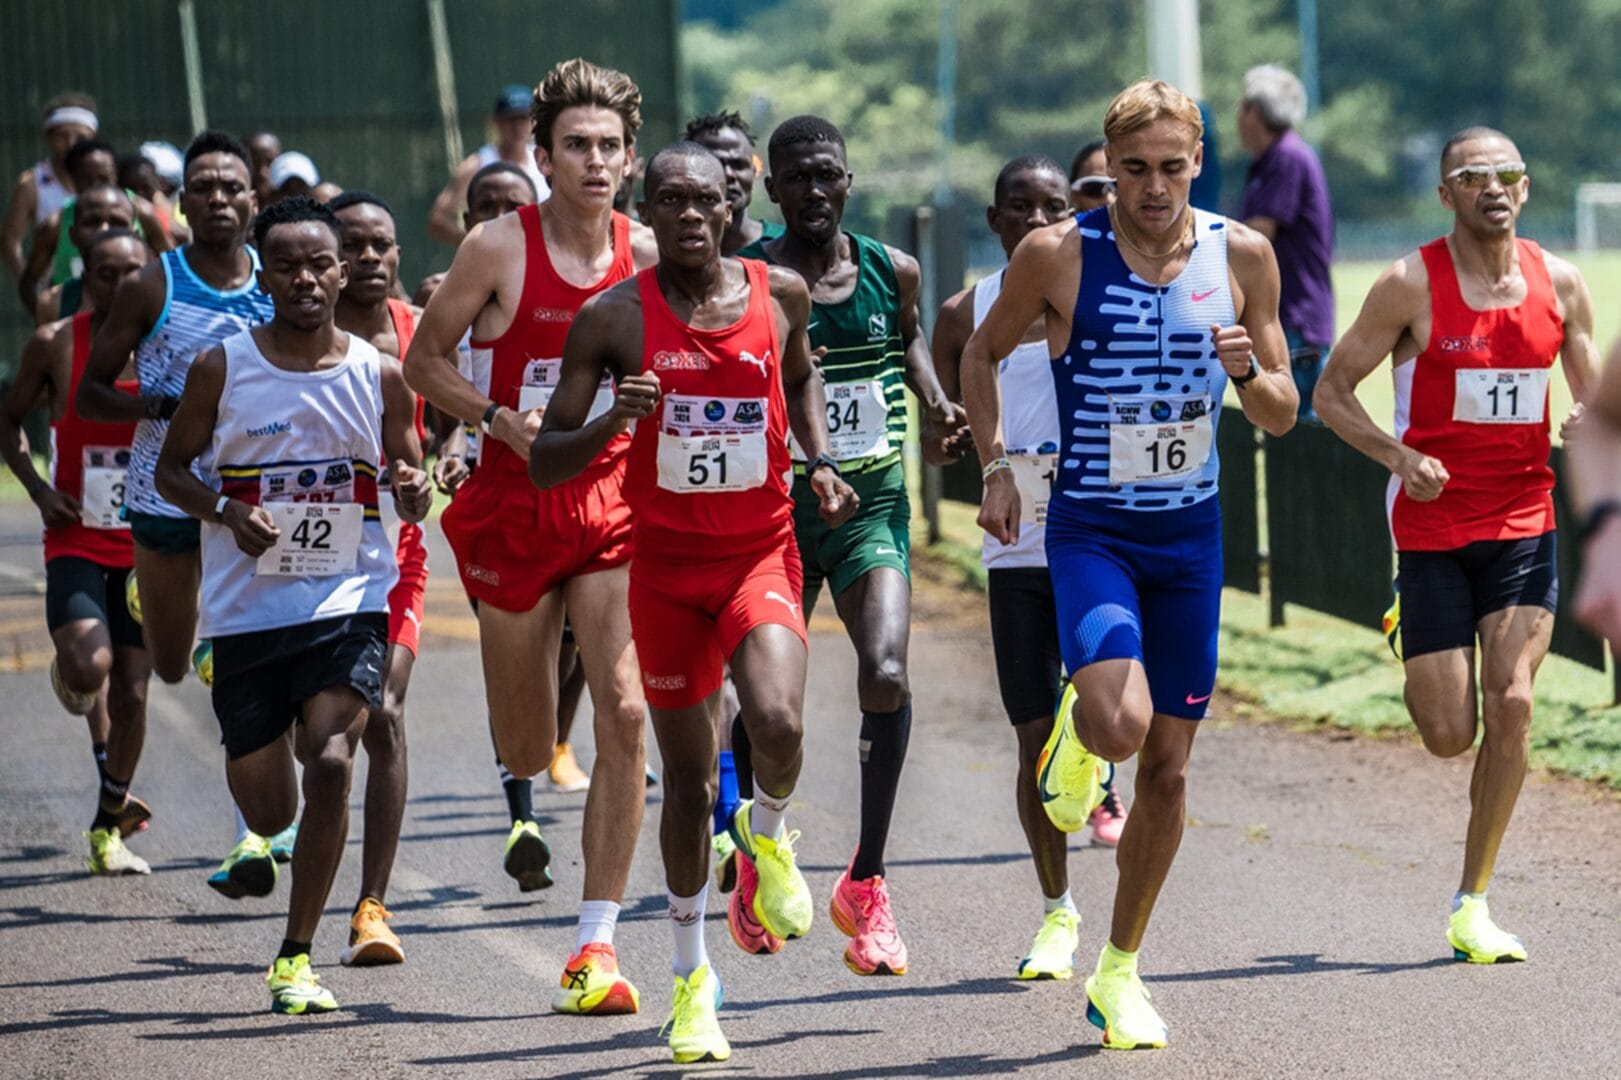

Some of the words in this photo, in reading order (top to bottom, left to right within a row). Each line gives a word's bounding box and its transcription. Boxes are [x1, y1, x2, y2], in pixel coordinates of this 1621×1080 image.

[737, 403, 761, 415] ASA
[1184, 402, 1205, 415] ASA
[1487, 385, 1519, 416] 11
[826, 399, 860, 434] 34
[688, 452, 727, 486] 51
[1145, 439, 1187, 474] 16
[328, 465, 348, 479] ASA
[111, 483, 126, 508] 3
[291, 519, 332, 549] 42
